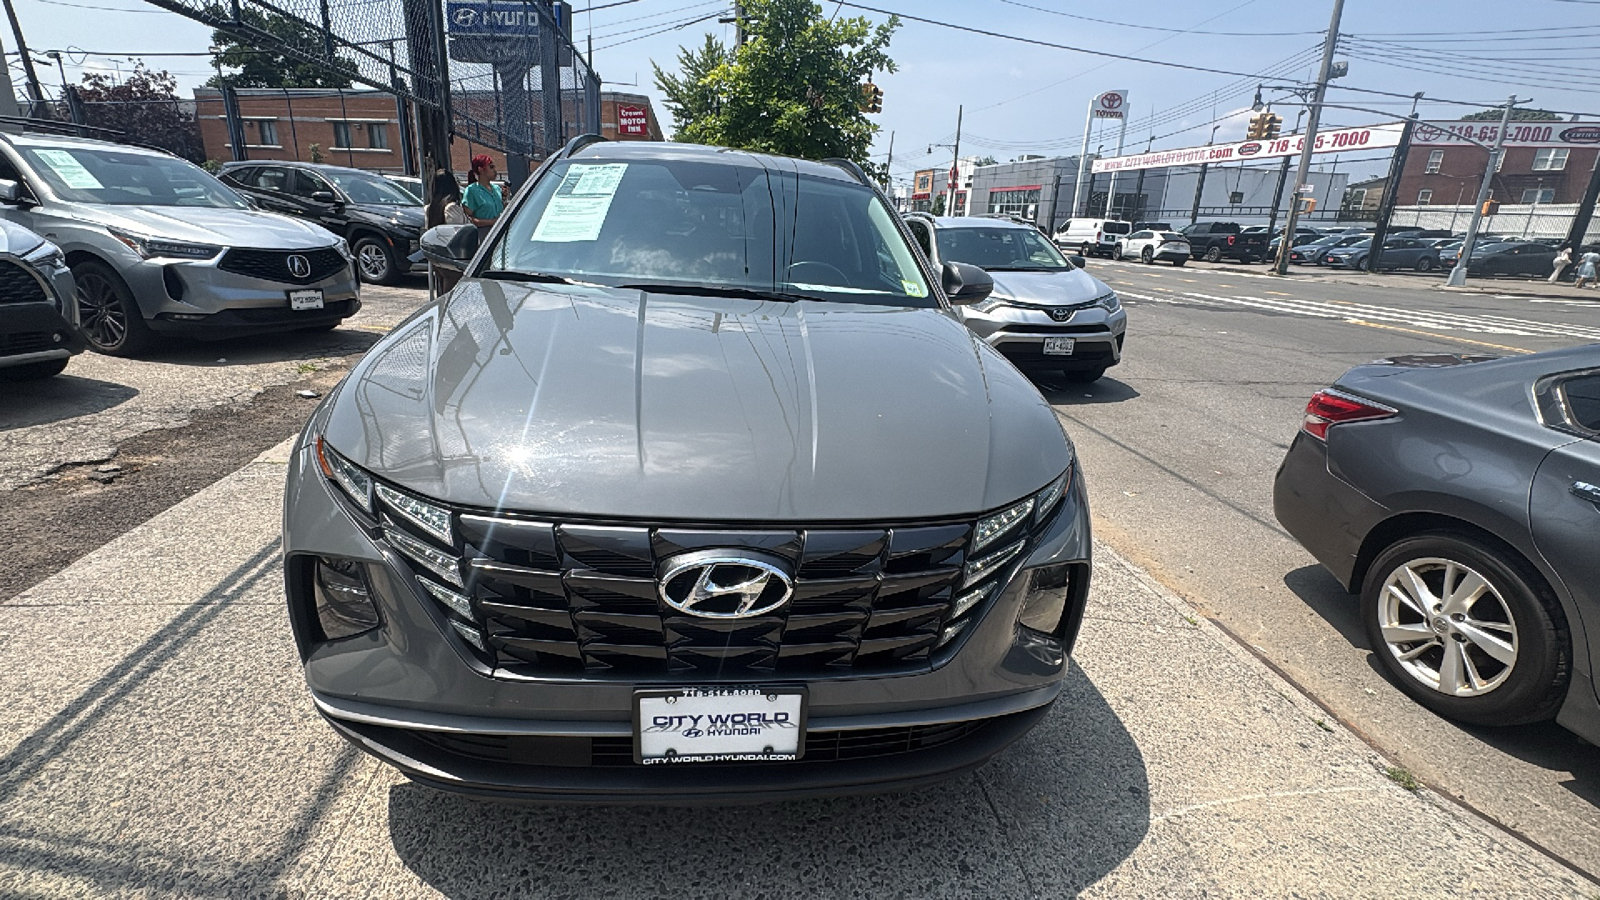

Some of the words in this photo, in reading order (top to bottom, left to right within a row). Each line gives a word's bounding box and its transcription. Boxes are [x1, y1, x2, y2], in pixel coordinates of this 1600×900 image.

[621, 109, 644, 117] Crown
[1095, 109, 1124, 119] TOYOTA
[620, 118, 646, 126] MOTOR
[627, 125, 642, 133] INN
[1268, 130, 1371, 154] 718-65-7000
[652, 715, 704, 727] CITY
[707, 712, 789, 724] WORLD
[707, 728, 761, 737] HYUNDAI
[642, 757, 669, 765] CITY
